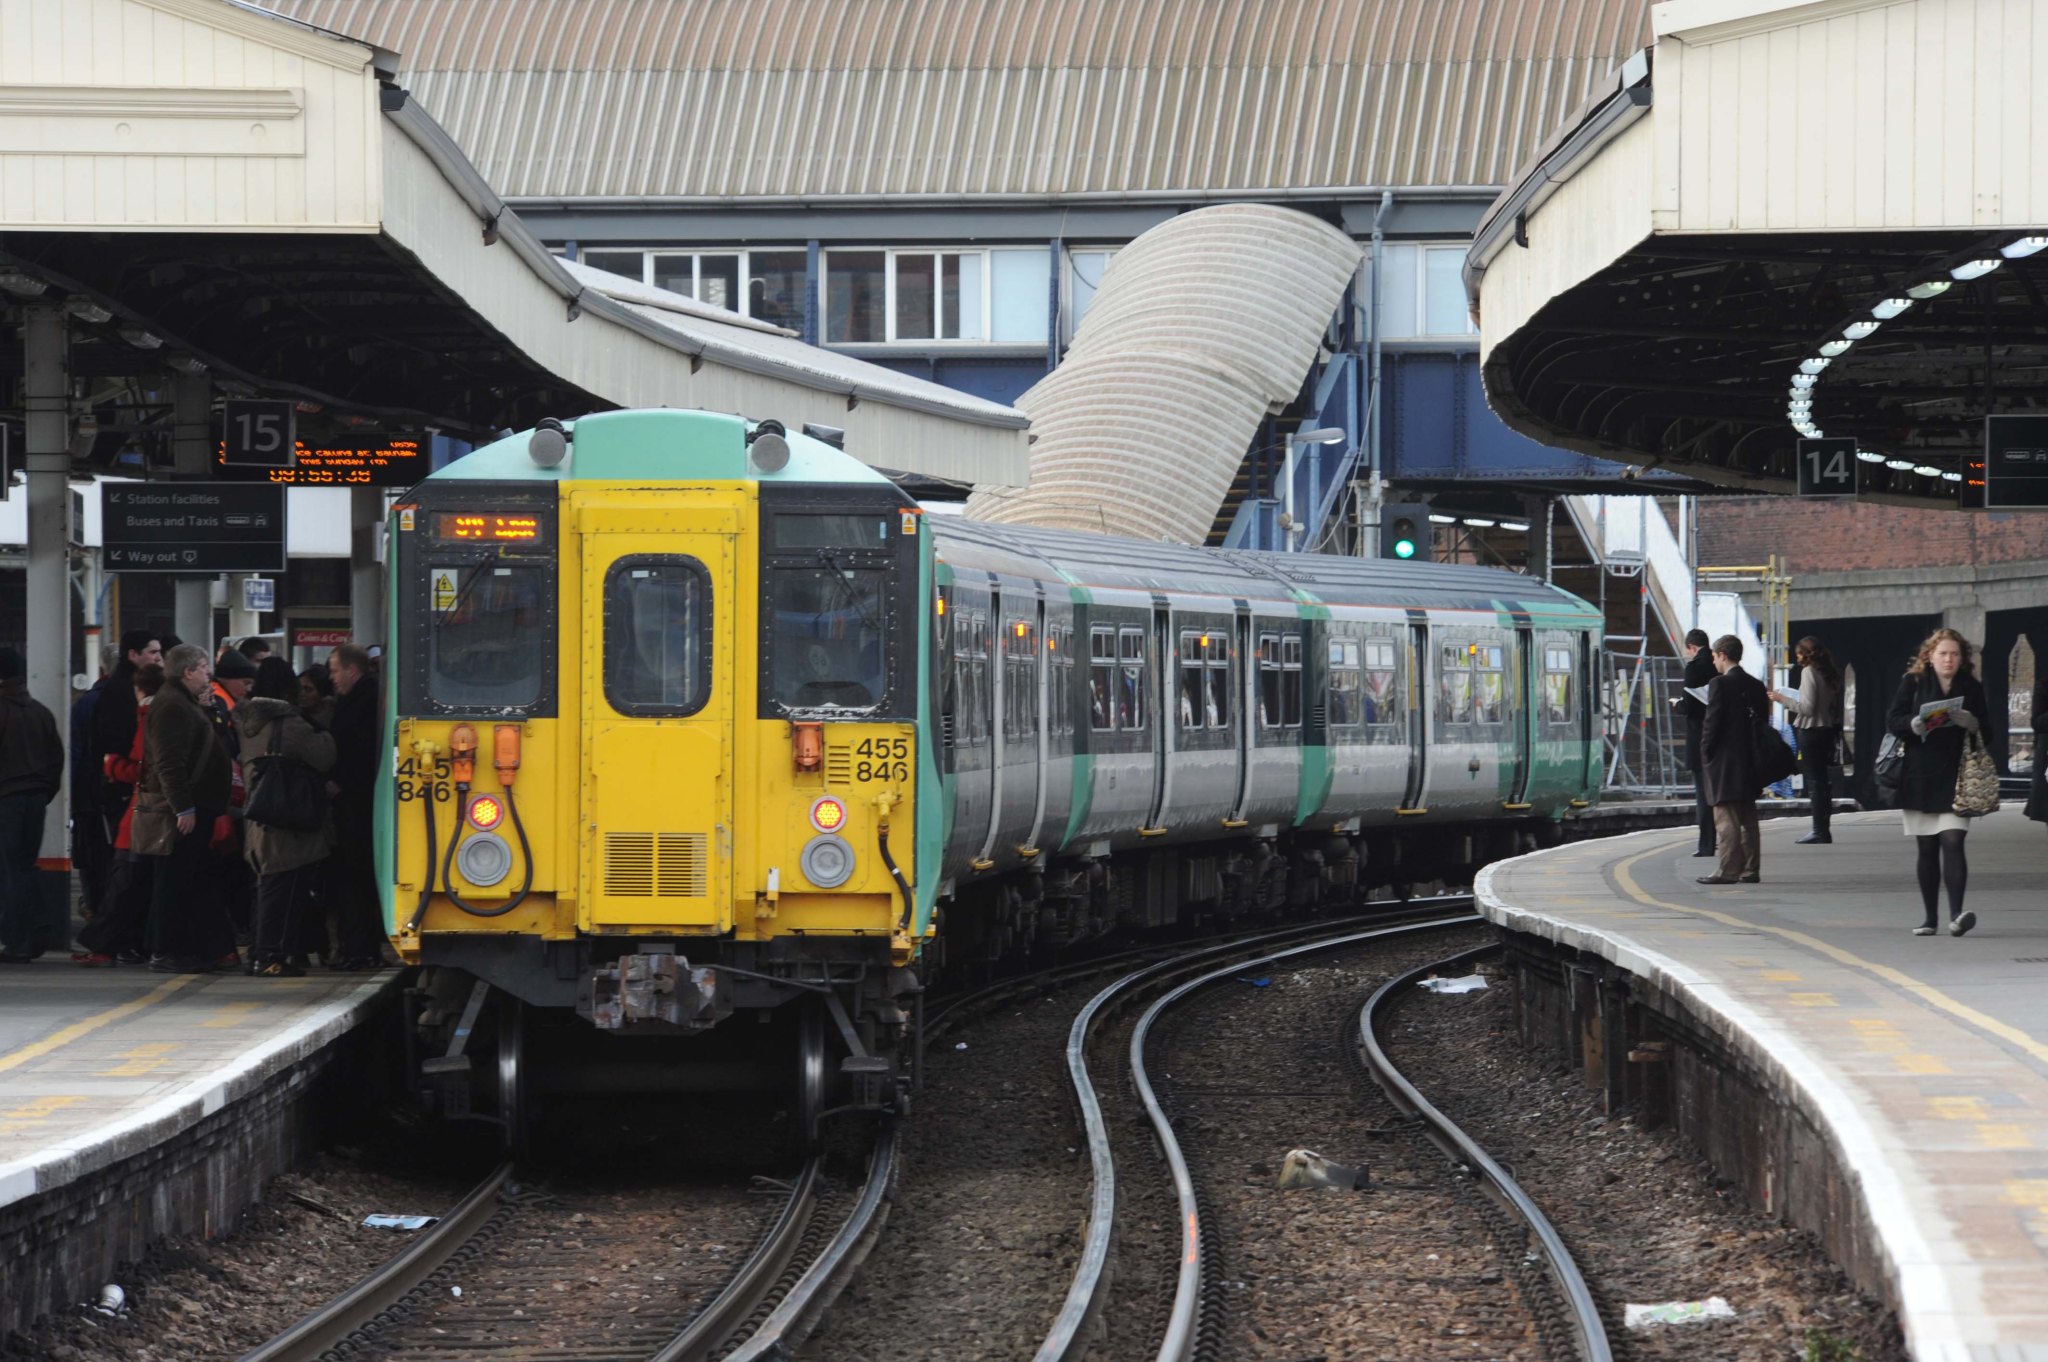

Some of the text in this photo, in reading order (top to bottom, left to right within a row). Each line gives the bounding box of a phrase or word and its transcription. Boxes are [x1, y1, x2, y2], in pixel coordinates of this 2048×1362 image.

[235, 413, 281, 452] 15
[1805, 450, 1850, 484] 14
[127, 493, 220, 504] Station facilities
[127, 516, 219, 527] Buses and Taxis
[128, 552, 177, 564] Way out
[856, 738, 908, 759] 455
[856, 761, 908, 782] 846
